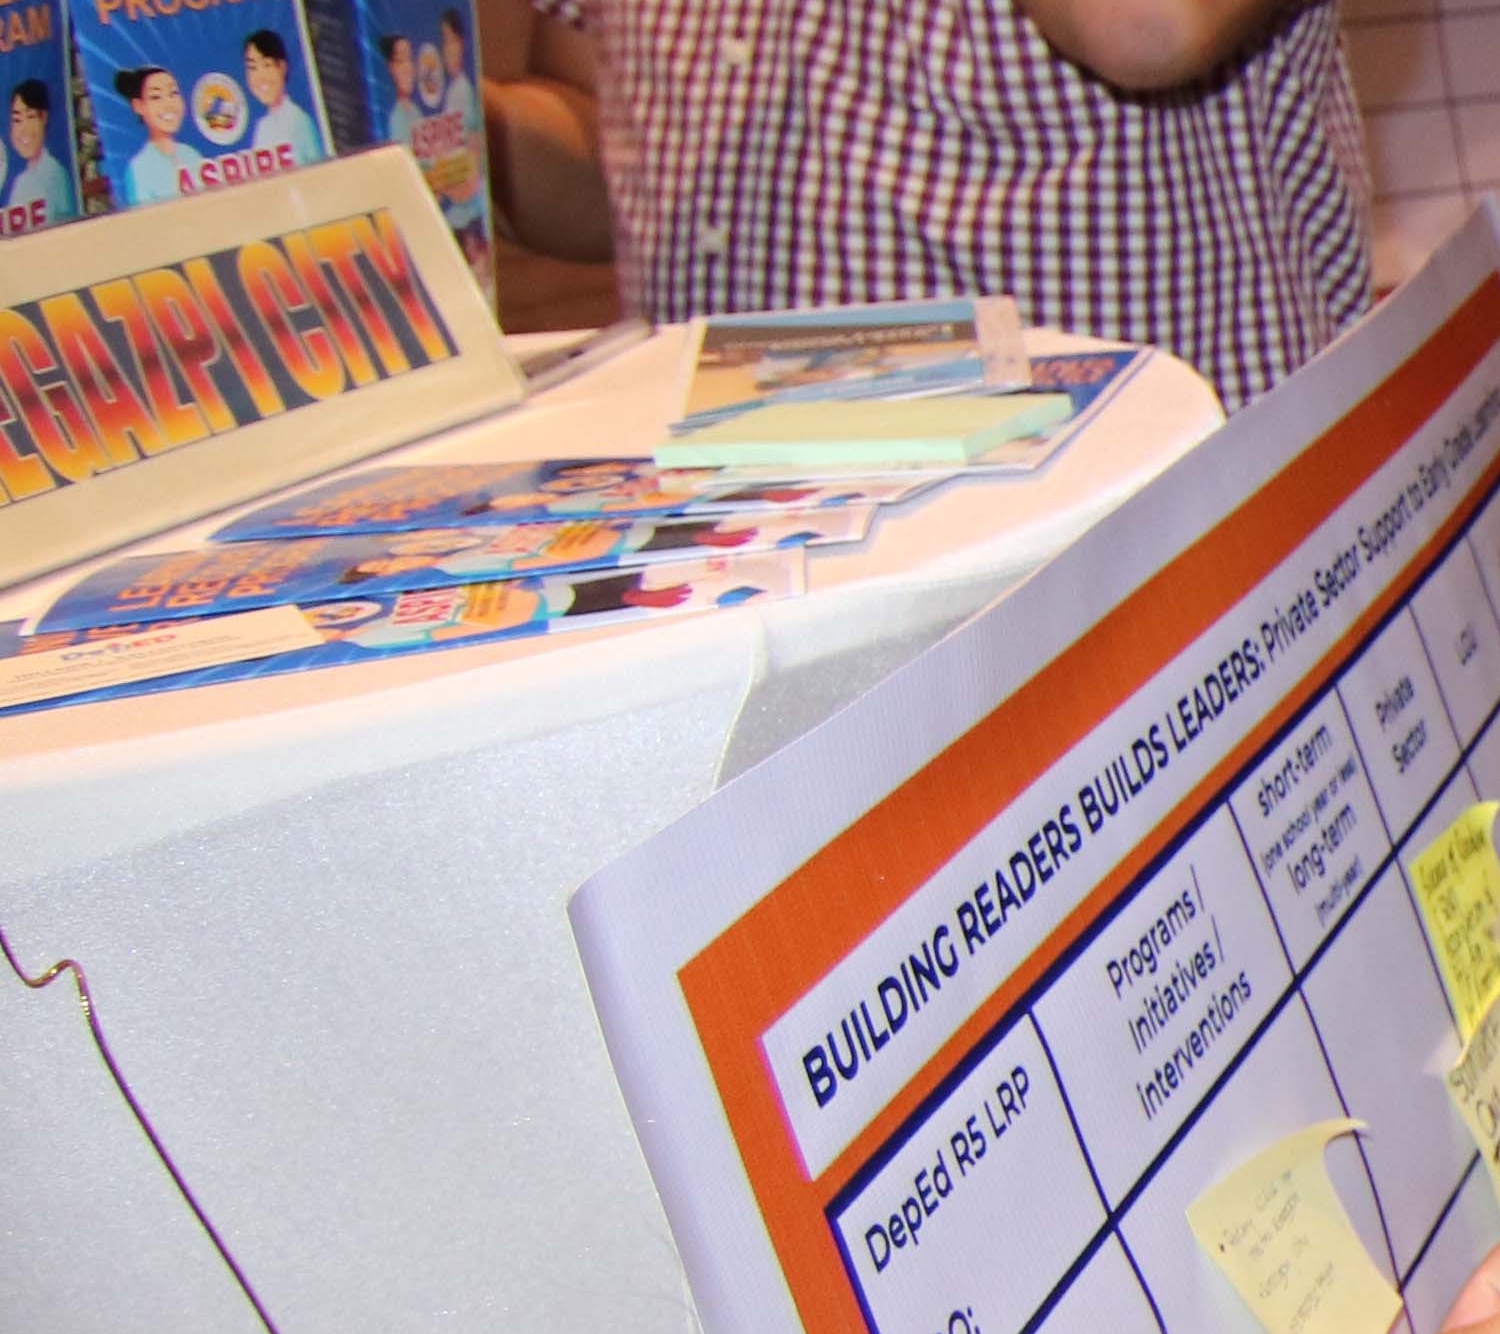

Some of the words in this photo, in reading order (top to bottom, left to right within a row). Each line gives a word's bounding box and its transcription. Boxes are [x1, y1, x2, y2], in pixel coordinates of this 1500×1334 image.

[0, 257, 286, 508] EGAZPI
[236, 208, 449, 401] CITY
[802, 926, 960, 1108] BUILDING
[956, 805, 1083, 955] READERS
[1079, 725, 1170, 835] BUILDS
[1165, 639, 1266, 752] LEADERS:
[1260, 600, 1320, 661] Private
[1314, 545, 1361, 619] Sector
[1358, 495, 1410, 564] Support
[1257, 724, 1334, 817] short-term
[1393, 718, 1430, 773] Sector
[1286, 804, 1358, 895] long-term
[1105, 889, 1196, 999] Programs
[1128, 939, 1216, 1055] Initiatives
[1136, 973, 1253, 1122] interventions
[865, 1151, 954, 1274] DepEd
[951, 1116, 987, 1178] R5
[984, 1065, 1032, 1146] LRP
